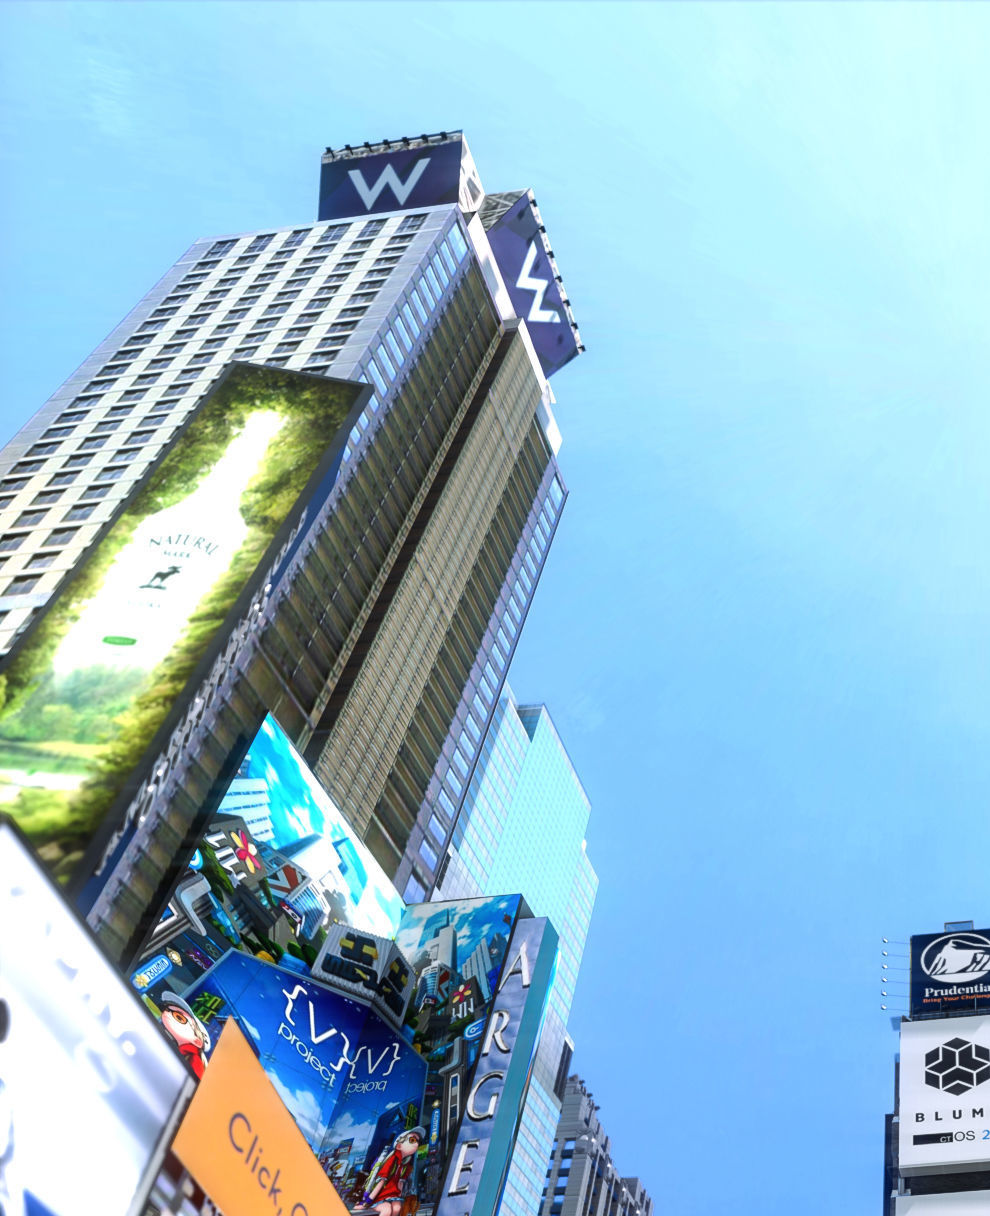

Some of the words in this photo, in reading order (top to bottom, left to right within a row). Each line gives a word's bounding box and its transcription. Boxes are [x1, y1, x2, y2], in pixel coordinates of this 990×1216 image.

[348, 157, 431, 211] W
[278, 1022, 336, 1087] project
[228, 1112, 282, 1216] Click,
